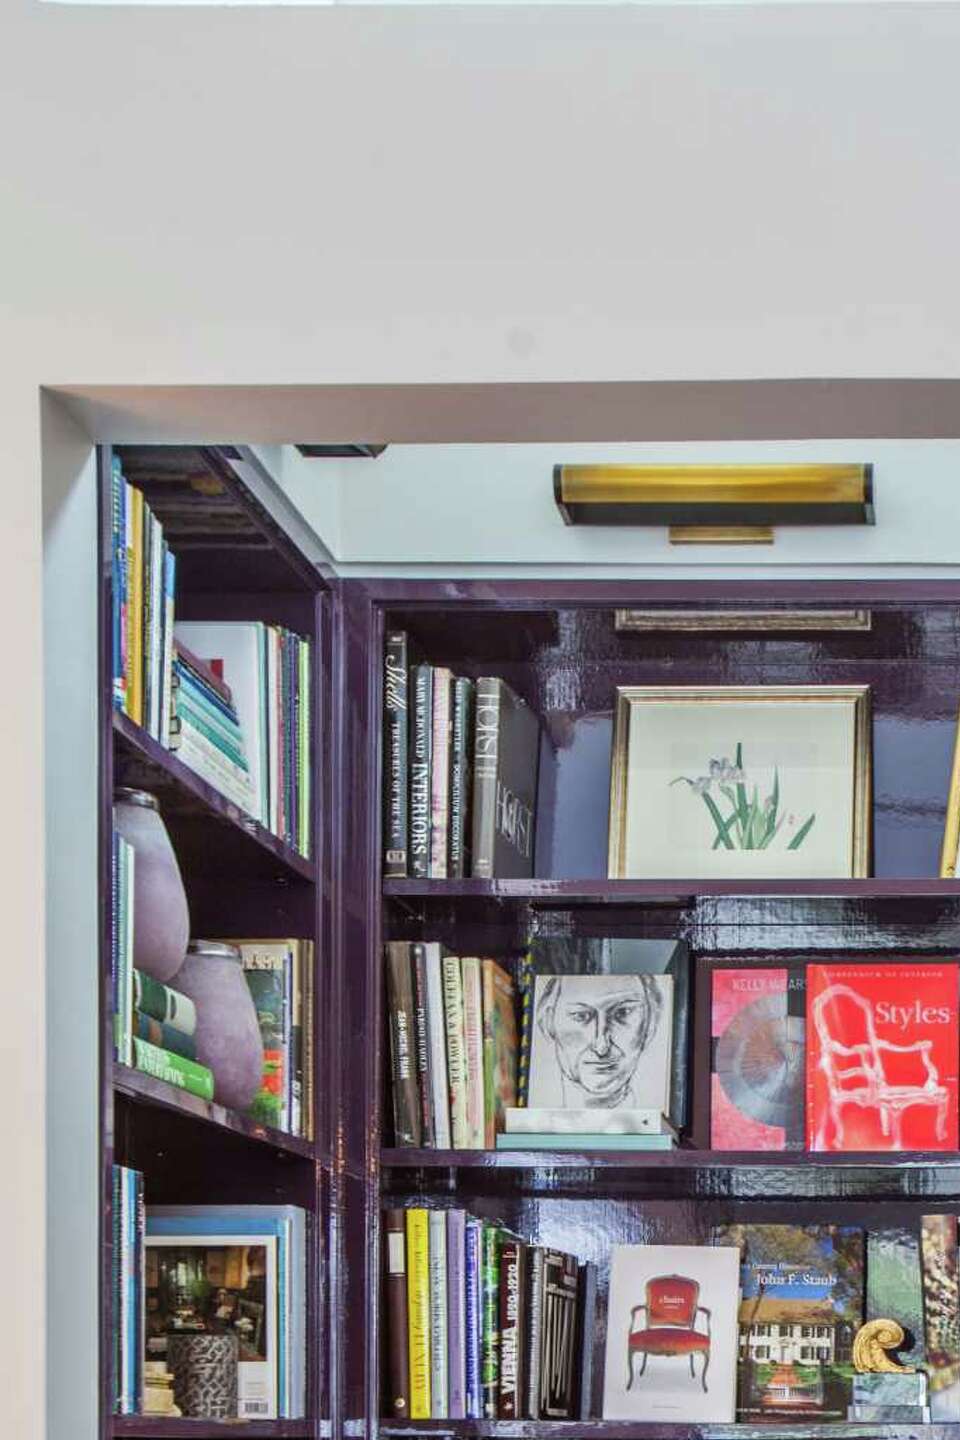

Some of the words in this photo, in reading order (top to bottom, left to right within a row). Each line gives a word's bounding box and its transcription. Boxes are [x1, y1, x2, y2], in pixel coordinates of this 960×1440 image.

[385, 654, 407, 712] Shells
[411, 762, 428, 855] INTERIORS
[875, 1000, 950, 1031] Styles
[501, 1328, 518, 1394] VIENNA
